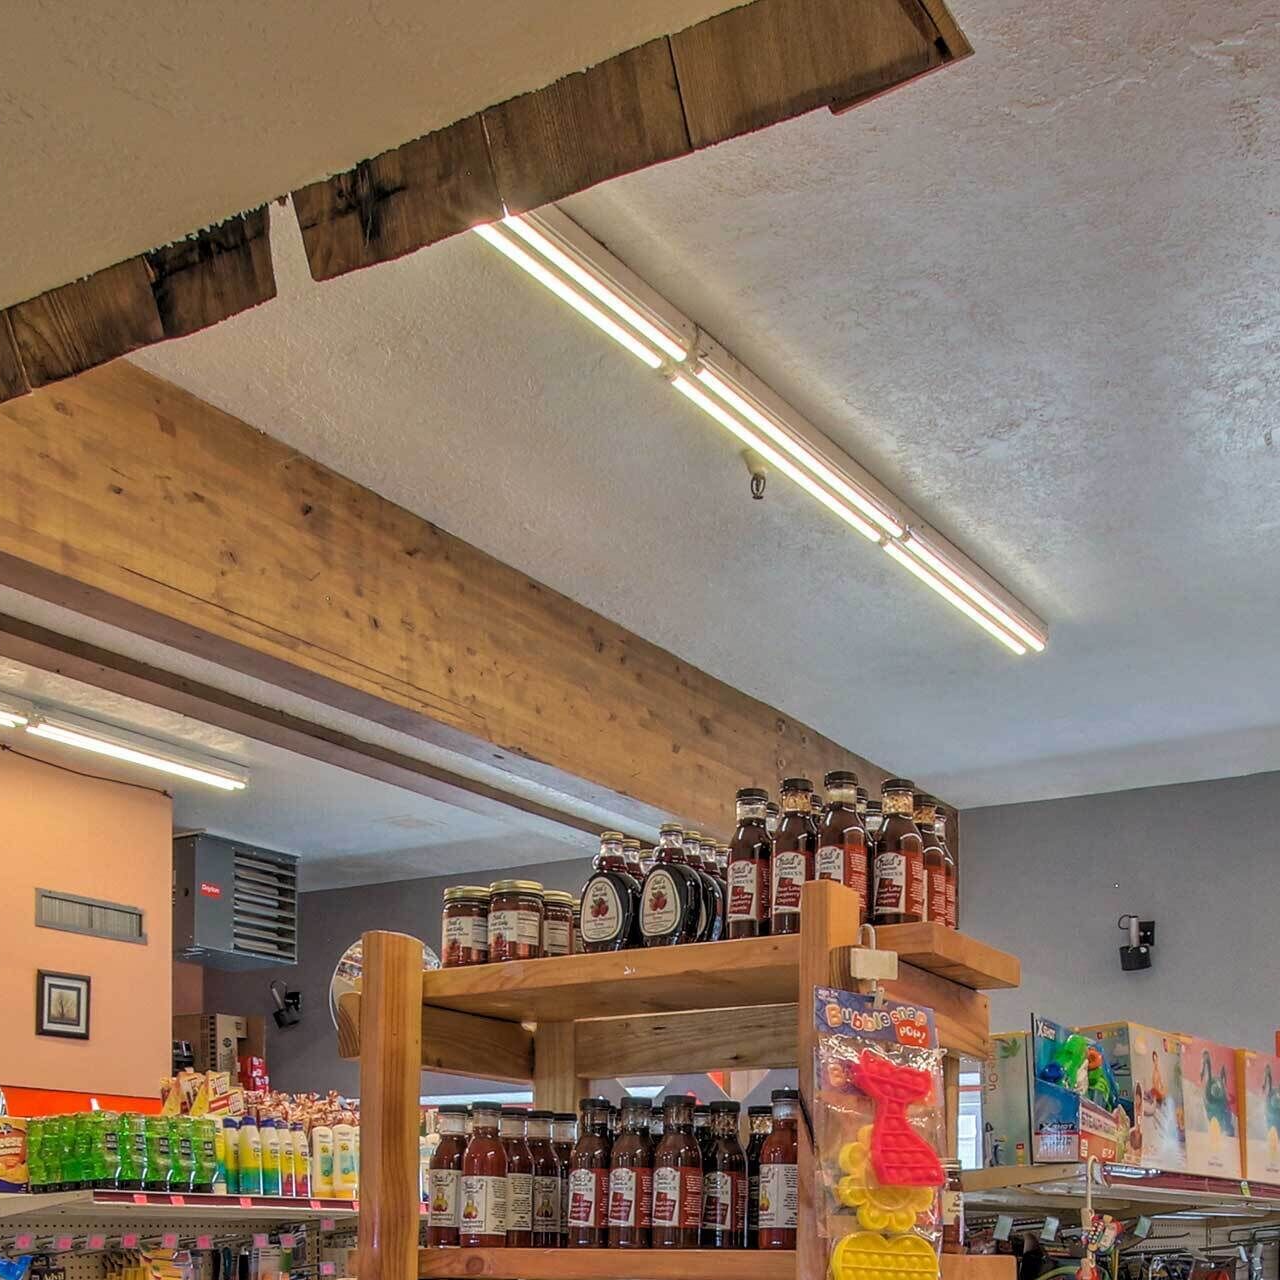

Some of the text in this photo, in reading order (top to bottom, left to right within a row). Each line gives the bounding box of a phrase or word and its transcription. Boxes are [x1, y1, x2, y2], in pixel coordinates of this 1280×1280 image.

[825, 1003, 927, 1033] Bubble snap
[898, 1024, 926, 1043] POP!
